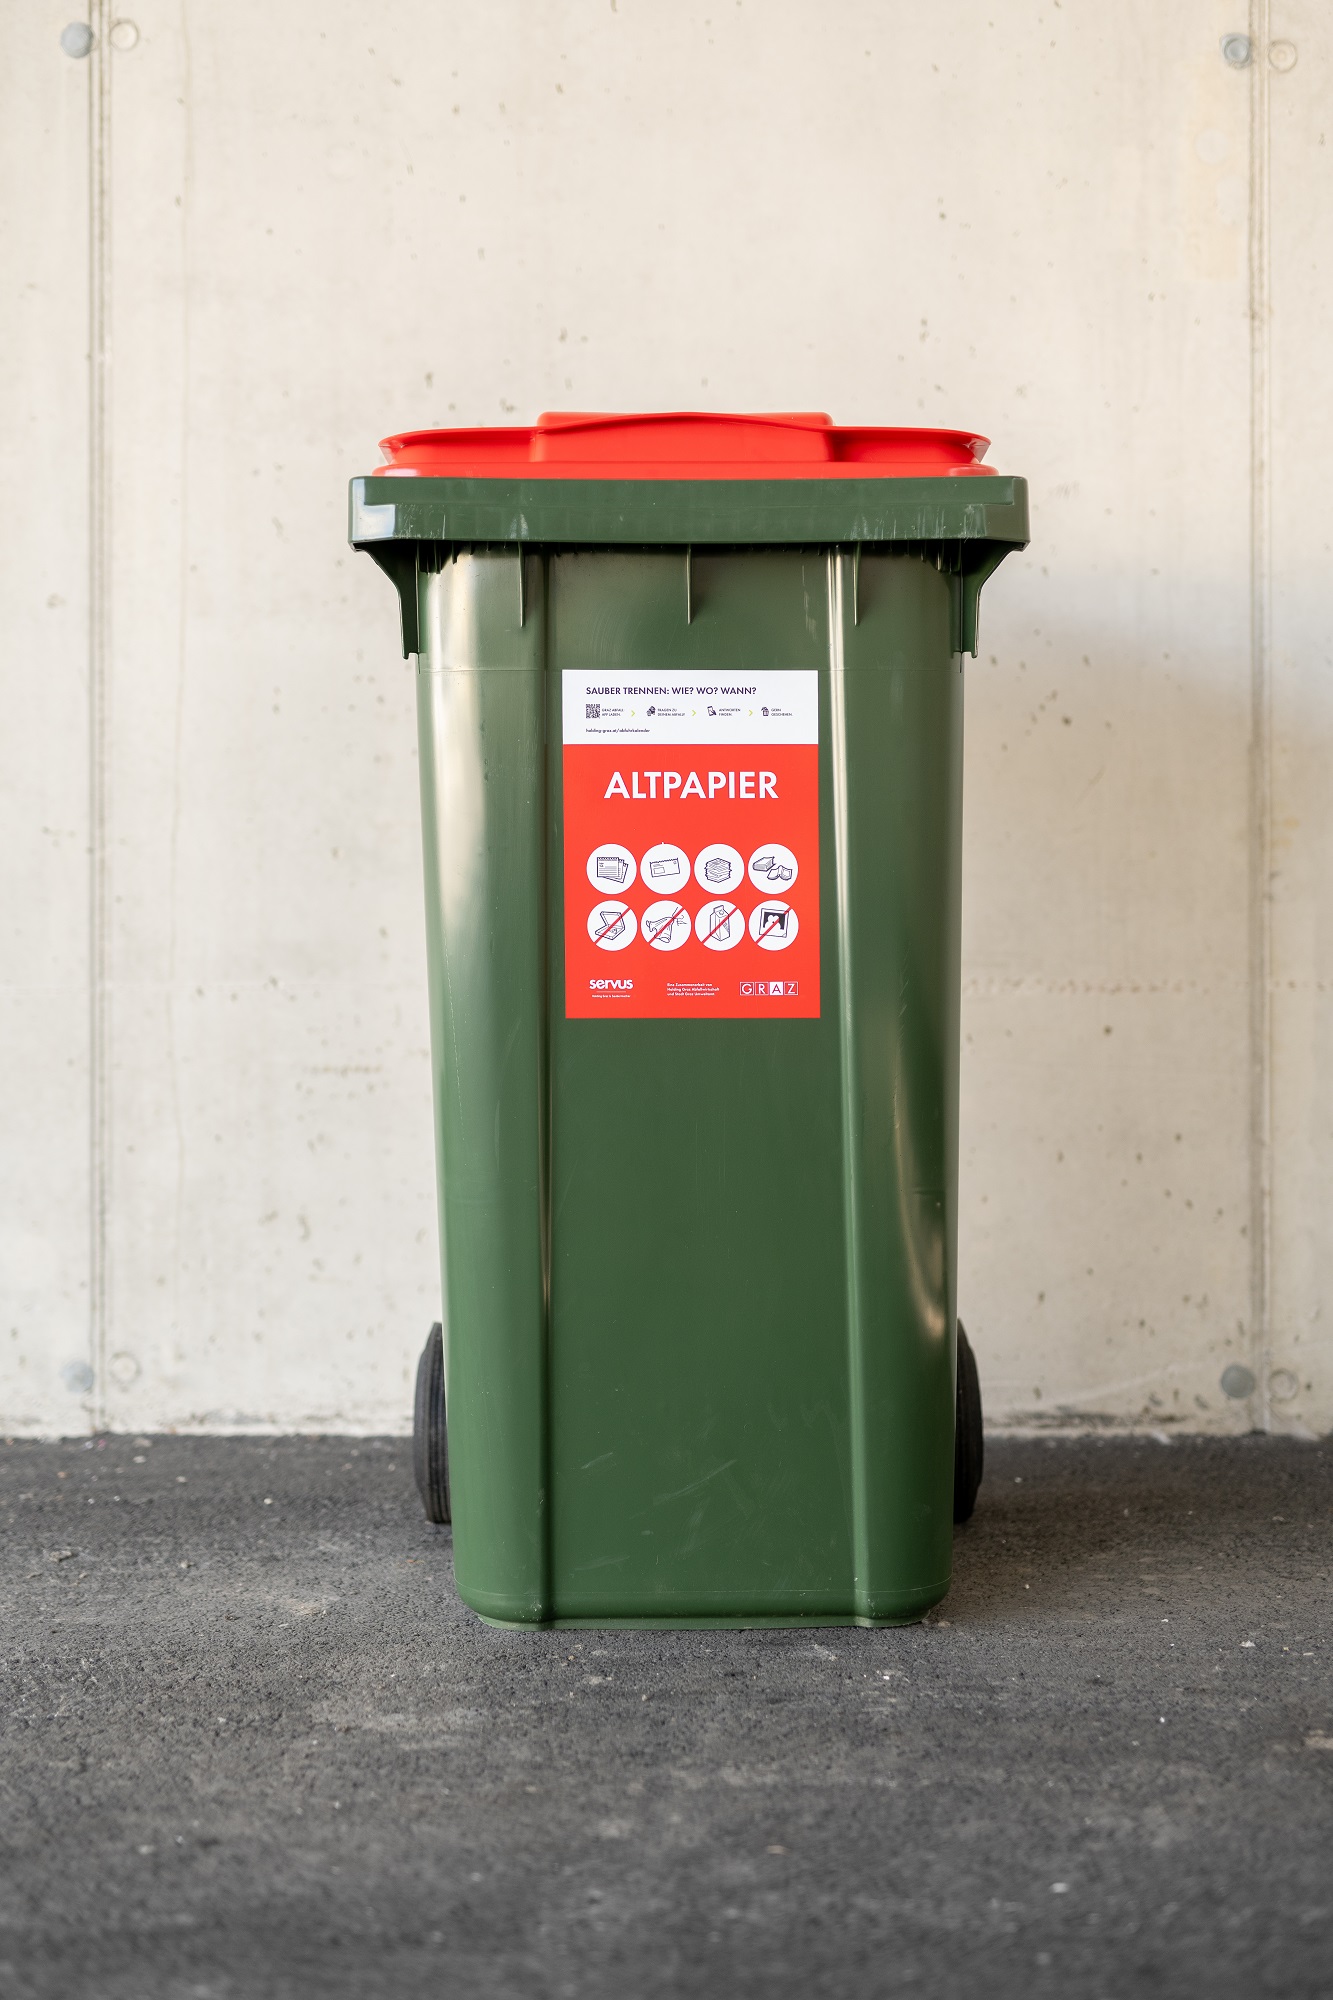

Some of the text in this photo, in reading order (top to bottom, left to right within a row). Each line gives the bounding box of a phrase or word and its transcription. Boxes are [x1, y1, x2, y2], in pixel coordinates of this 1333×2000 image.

[585, 686, 757, 695] SAUBER TRENNEN: WIE? WO? WANN?
[603, 771, 780, 799] ALTPAPIER
[589, 979, 634, 990] servus
[740, 981, 799, 996] GRAZ
